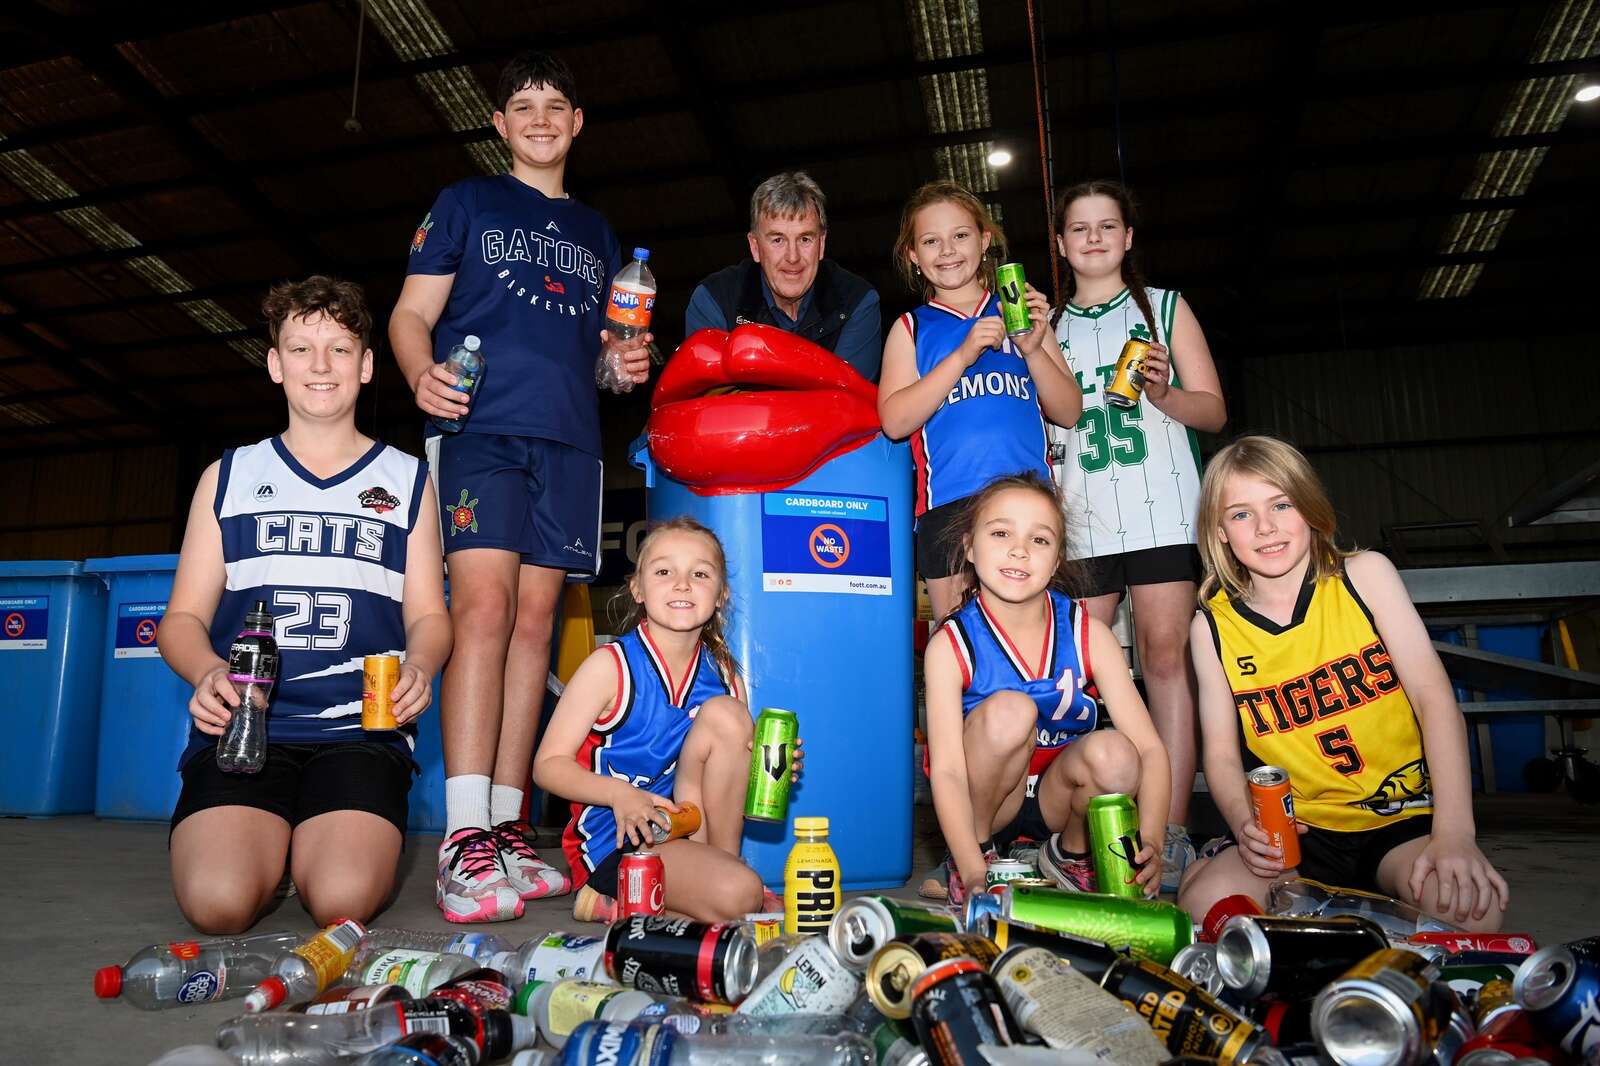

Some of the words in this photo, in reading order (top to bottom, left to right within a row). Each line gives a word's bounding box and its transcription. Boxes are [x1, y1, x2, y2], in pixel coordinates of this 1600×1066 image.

[482, 229, 604, 294] GATORS
[612, 290, 640, 305] FANTA
[946, 372, 1031, 405] EMONS
[1076, 400, 1149, 474] 35
[785, 497, 844, 508] CARDBOARD
[845, 501, 869, 511] ONLY
[254, 513, 385, 561] CATS
[816, 545, 844, 554] WASTE
[823, 537, 836, 545] NO
[849, 581, 887, 590] foott.com.au
[272, 590, 352, 651] 23
[1234, 640, 1401, 737] TIGERS
[1314, 724, 1366, 777] 5
[795, 953, 827, 990] LEMON
